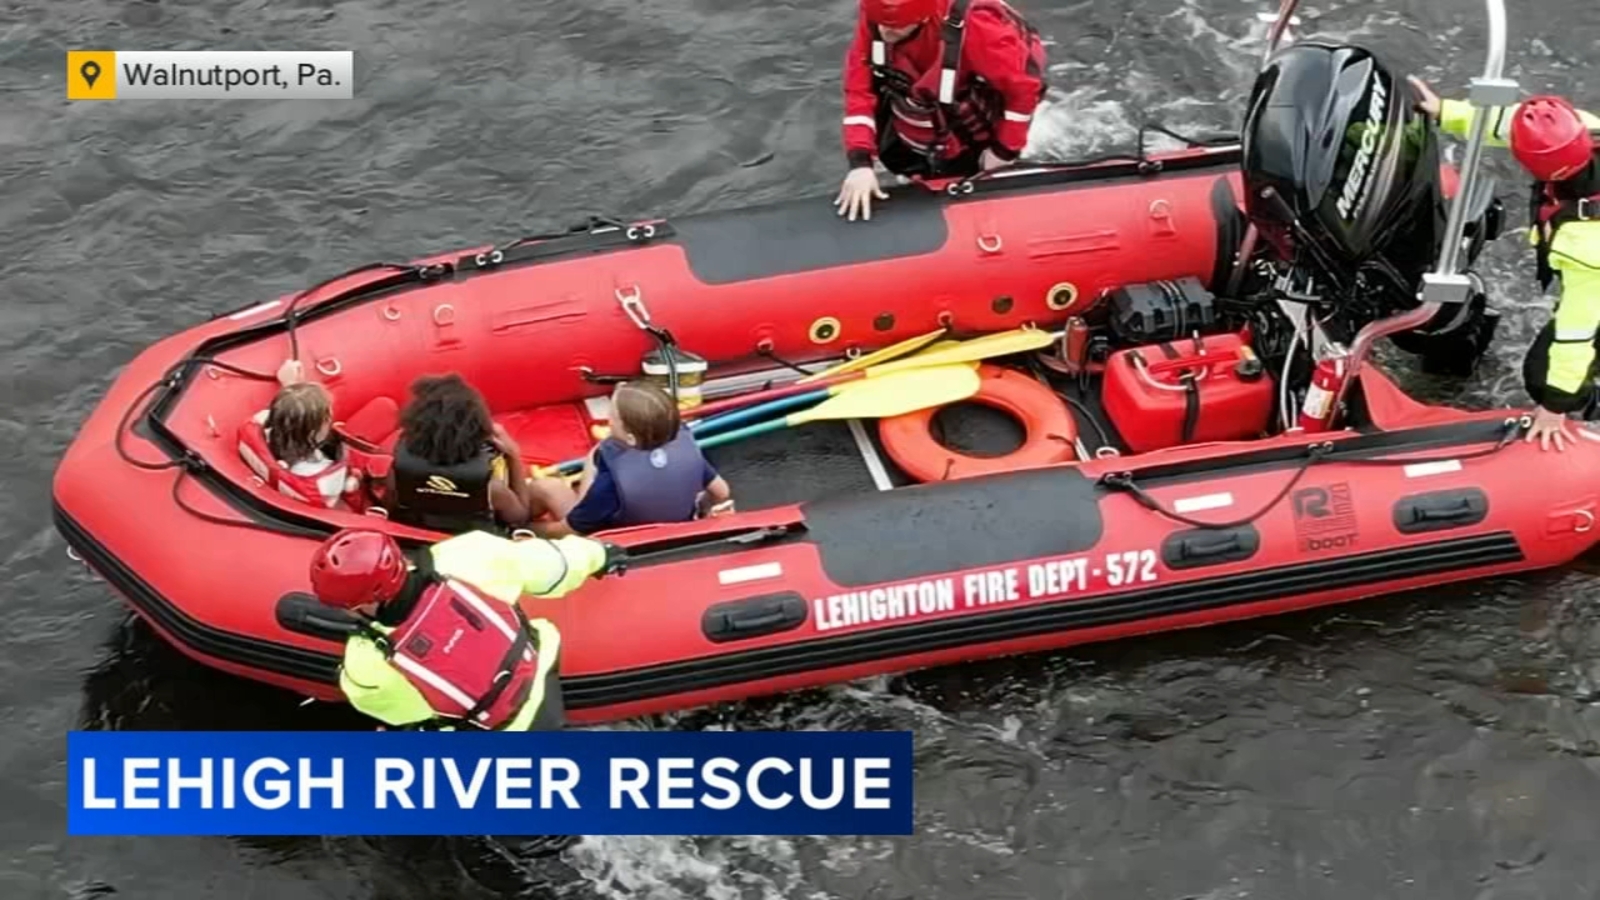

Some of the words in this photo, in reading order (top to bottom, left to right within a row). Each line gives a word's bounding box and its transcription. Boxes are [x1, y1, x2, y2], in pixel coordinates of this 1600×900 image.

[1336, 70, 1386, 219] MERCURY
[814, 578, 955, 631] LEHIGHTON
[963, 569, 1020, 608] FIRE
[1106, 549, 1157, 586] 572
